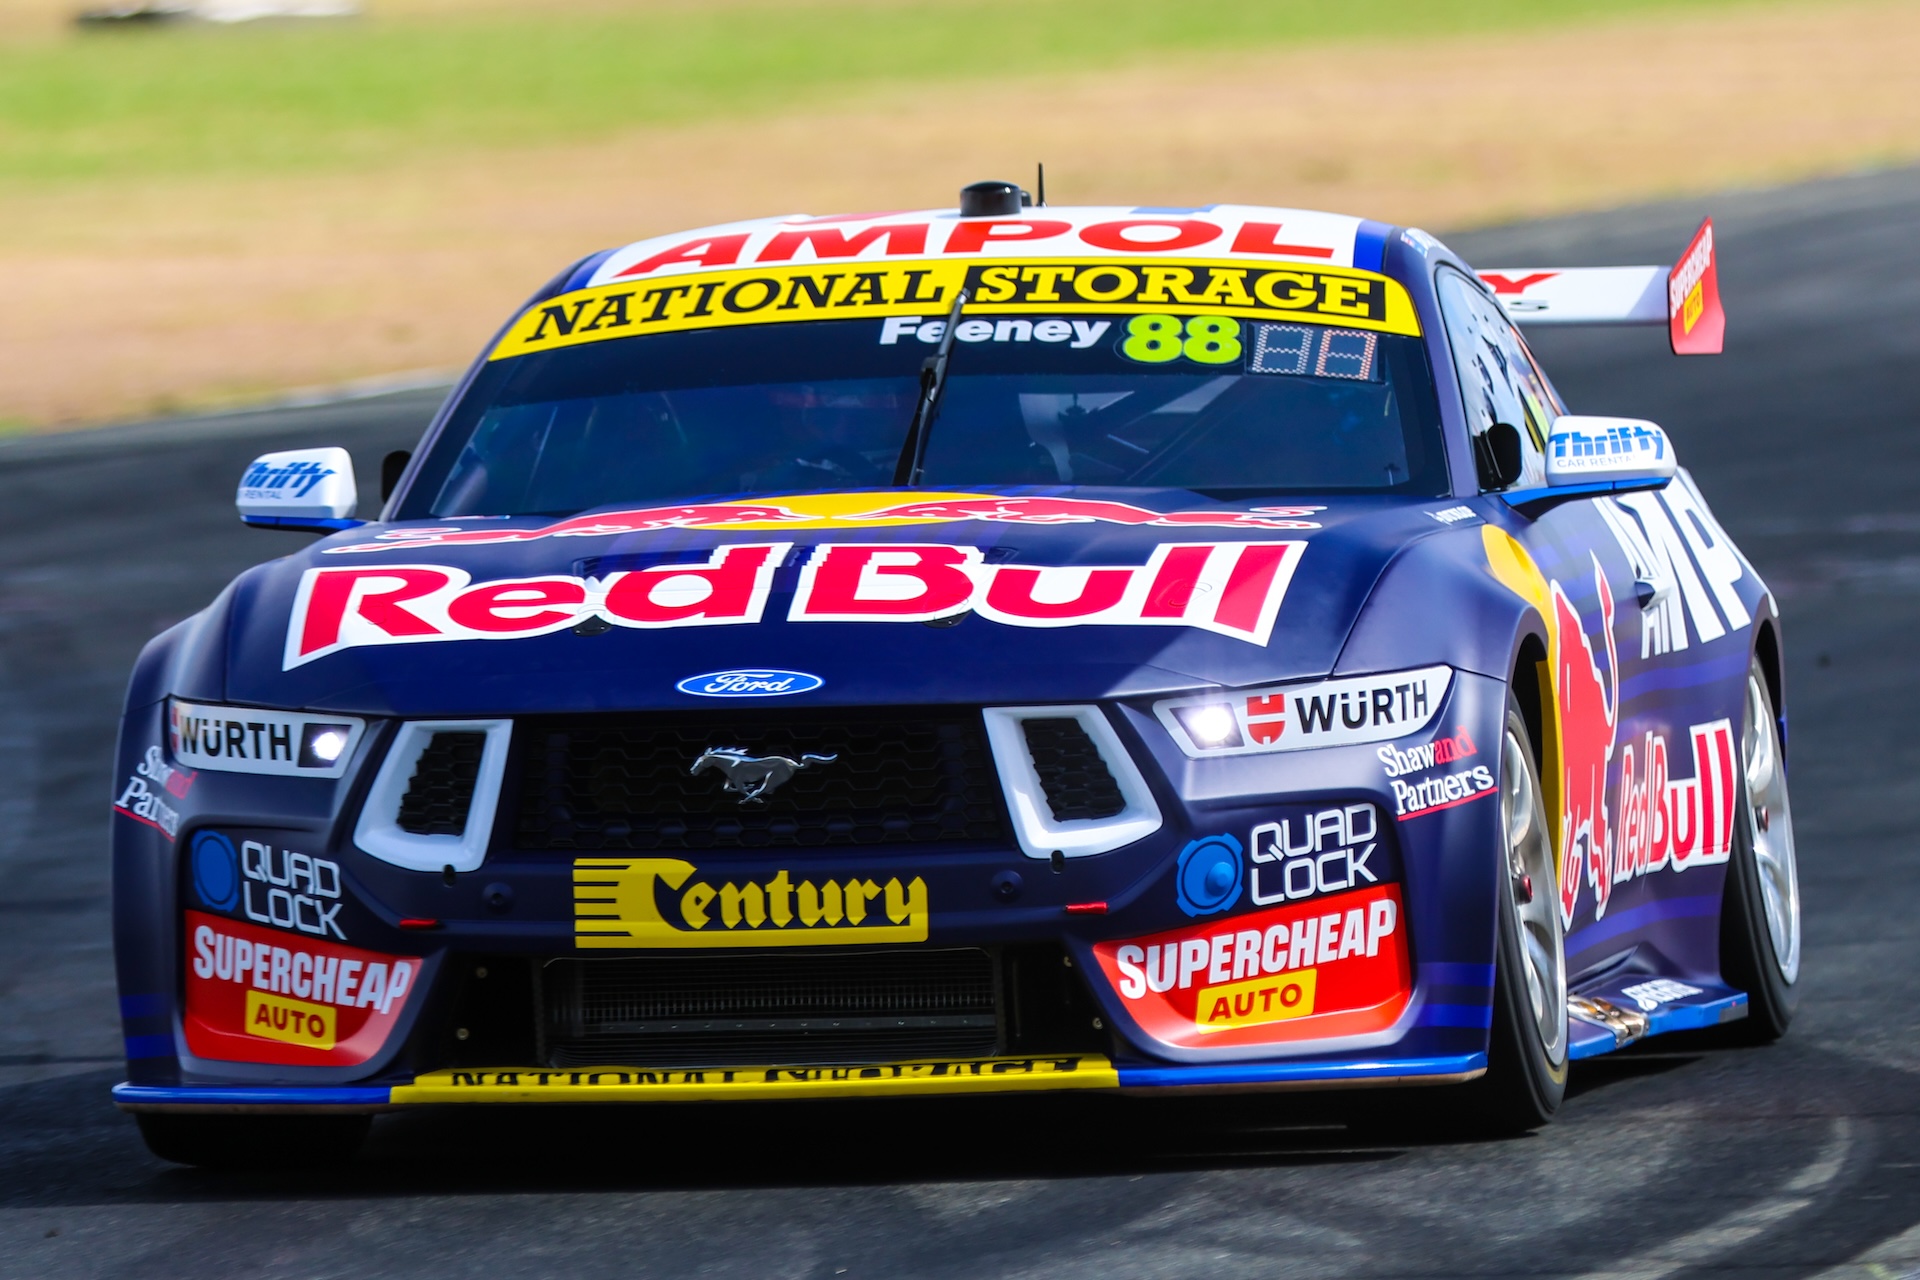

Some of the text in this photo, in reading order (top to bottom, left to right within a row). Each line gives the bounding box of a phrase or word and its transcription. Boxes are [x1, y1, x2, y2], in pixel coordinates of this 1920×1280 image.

[611, 219, 1334, 279] AMPOL
[523, 265, 1373, 343] NATIONAL STORAGE
[878, 315, 1112, 348] Feeney
[1121, 313, 1242, 364] 88
[1549, 426, 1664, 460] Thrifty
[1557, 458, 1586, 468] CAR
[291, 543, 1298, 662] Red Bull
[704, 672, 796, 693] Ford
[1294, 678, 1429, 736] WÜRTH
[179, 714, 294, 763] WÜRTH
[1390, 764, 1495, 817] Partners
[1614, 722, 1736, 881] Red Bull
[1250, 802, 1378, 863] QUAD
[241, 840, 341, 899] QUAD
[1250, 842, 1379, 907] LOCK
[243, 880, 348, 940] LOCK
[574, 857, 929, 950] Century
[193, 925, 413, 1015] SUPERCHEAP
[1115, 897, 1398, 1001] SUPERCHEAP
[254, 1003, 326, 1039] AUTO
[1207, 983, 1303, 1023] AUTO
